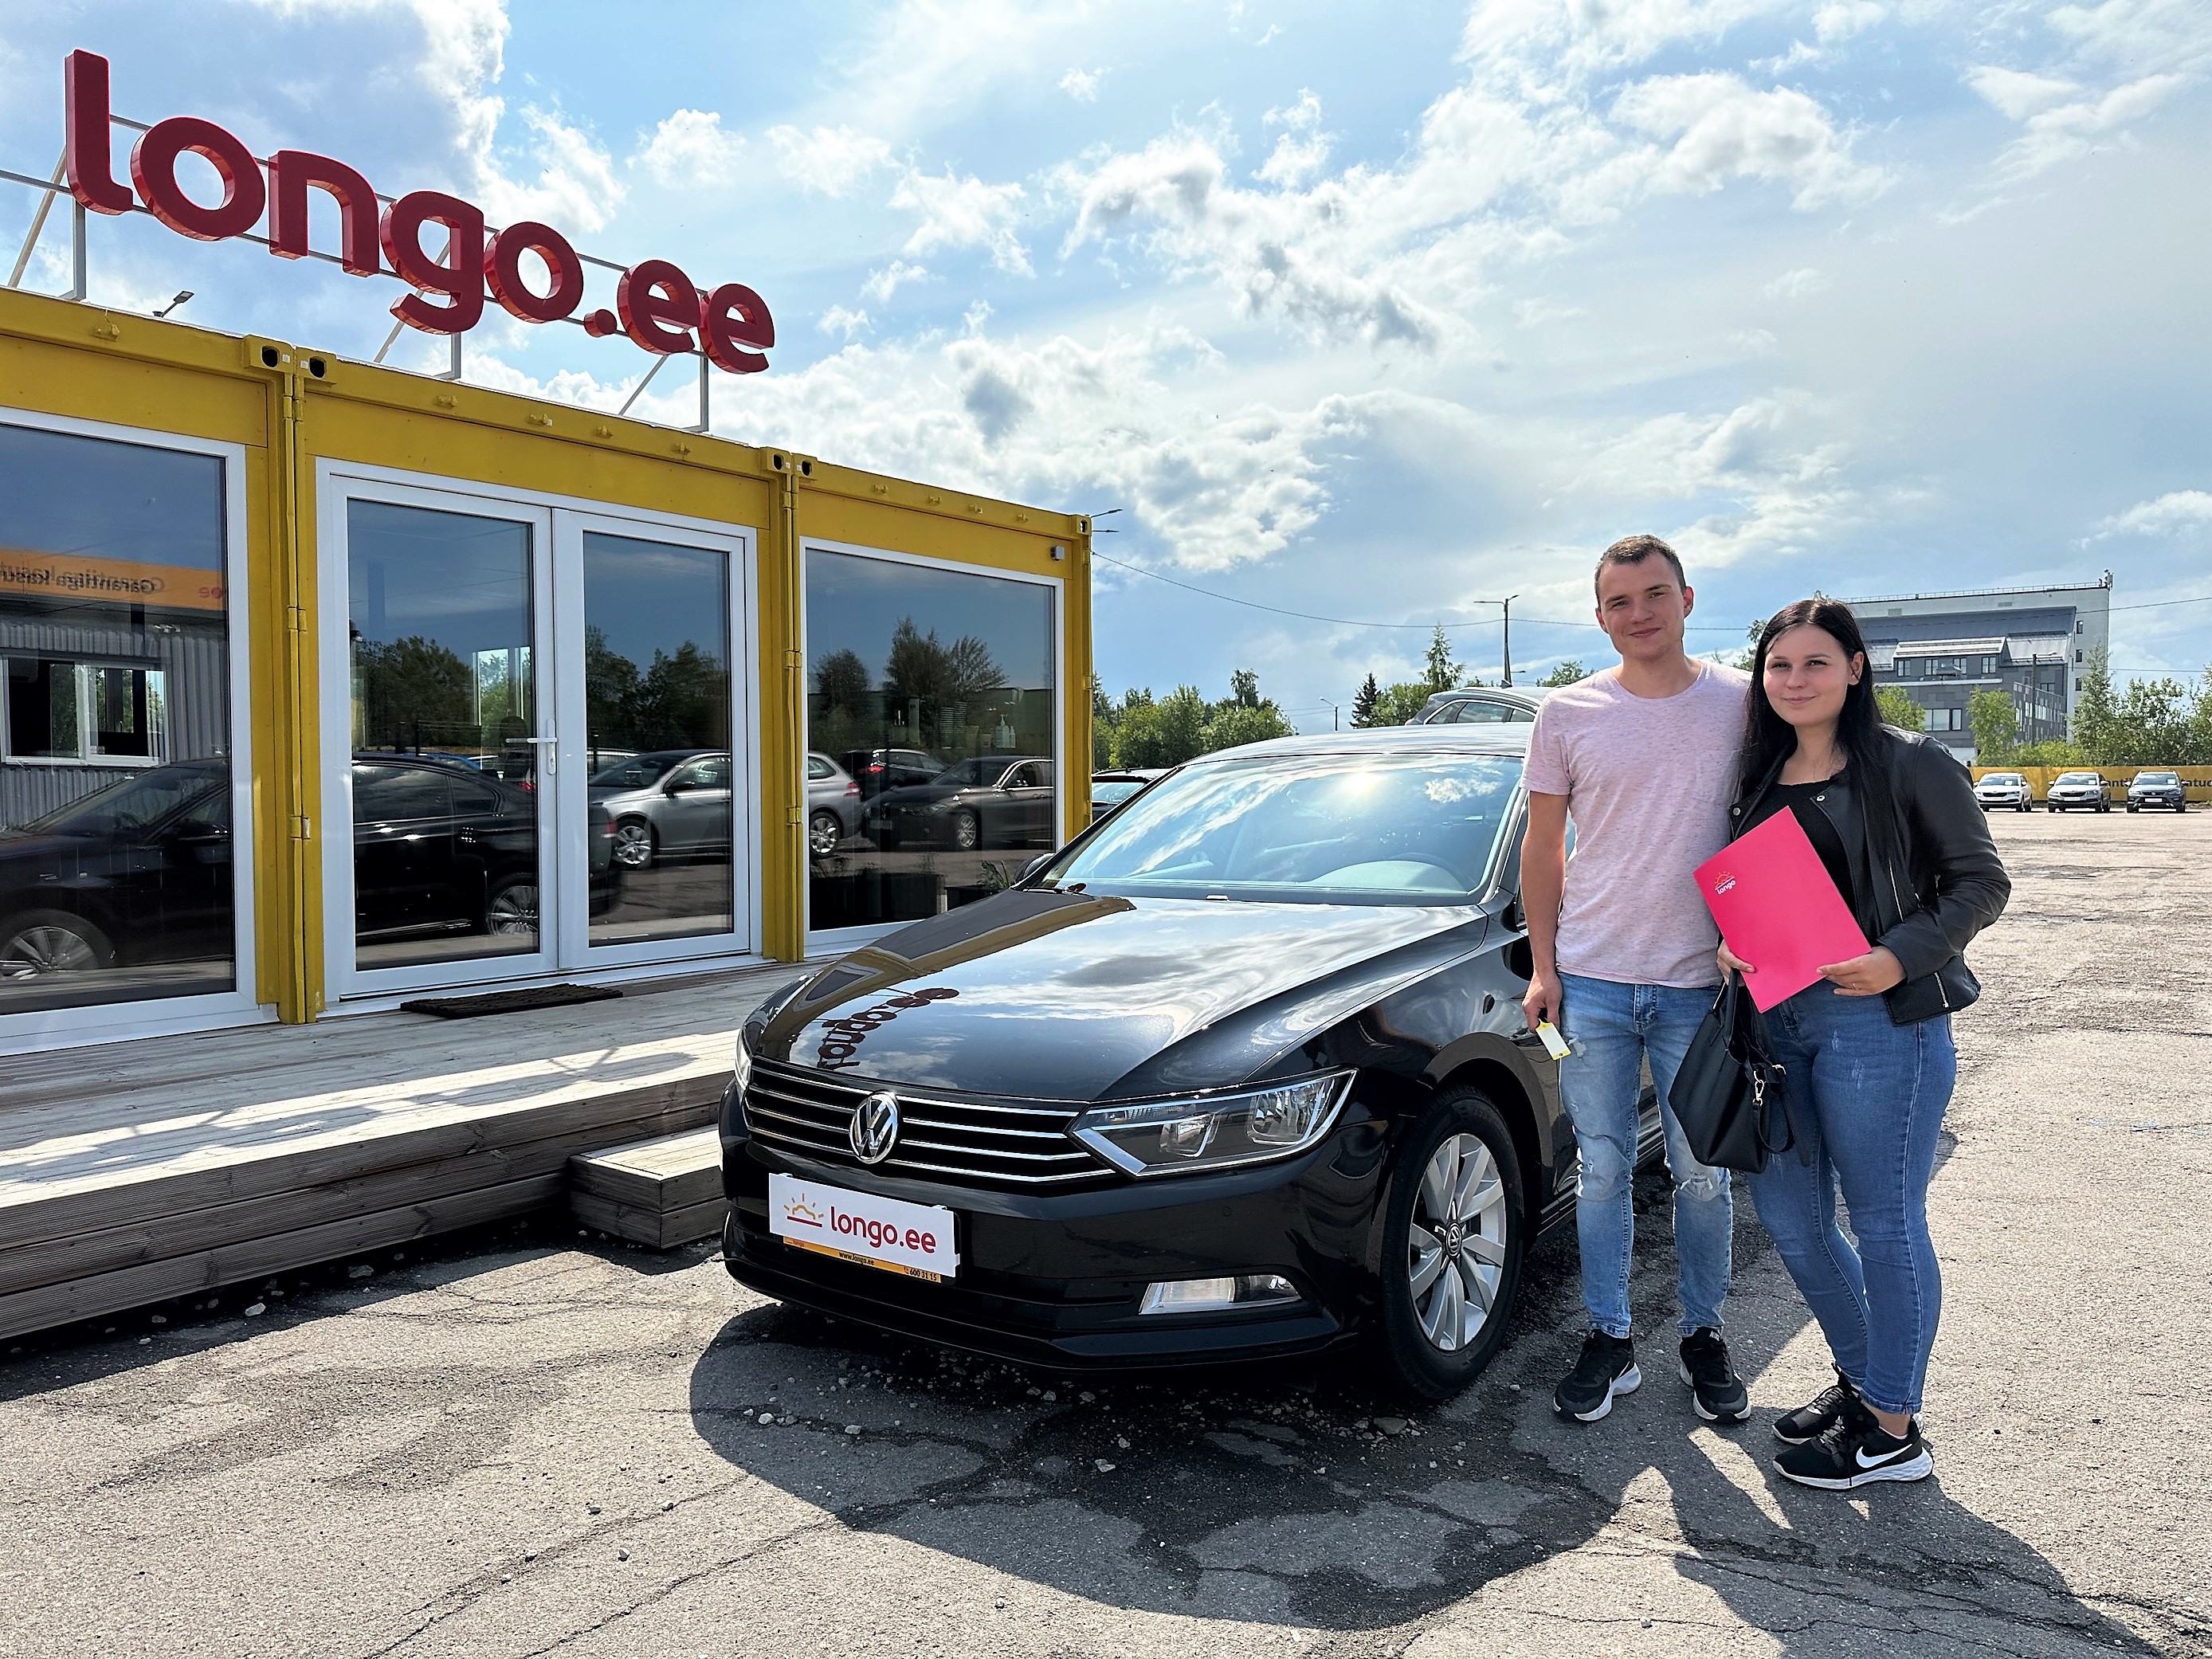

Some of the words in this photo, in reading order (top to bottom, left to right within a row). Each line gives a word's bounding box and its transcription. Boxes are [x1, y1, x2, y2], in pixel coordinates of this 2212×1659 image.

[65, 49, 775, 375] longo.ee
[1716, 880, 1736, 895] longo
[830, 1206, 937, 1253] longo.ee
[838, 1251, 875, 1265] www.longo.ee
[909, 1268, 920, 1277] 600
